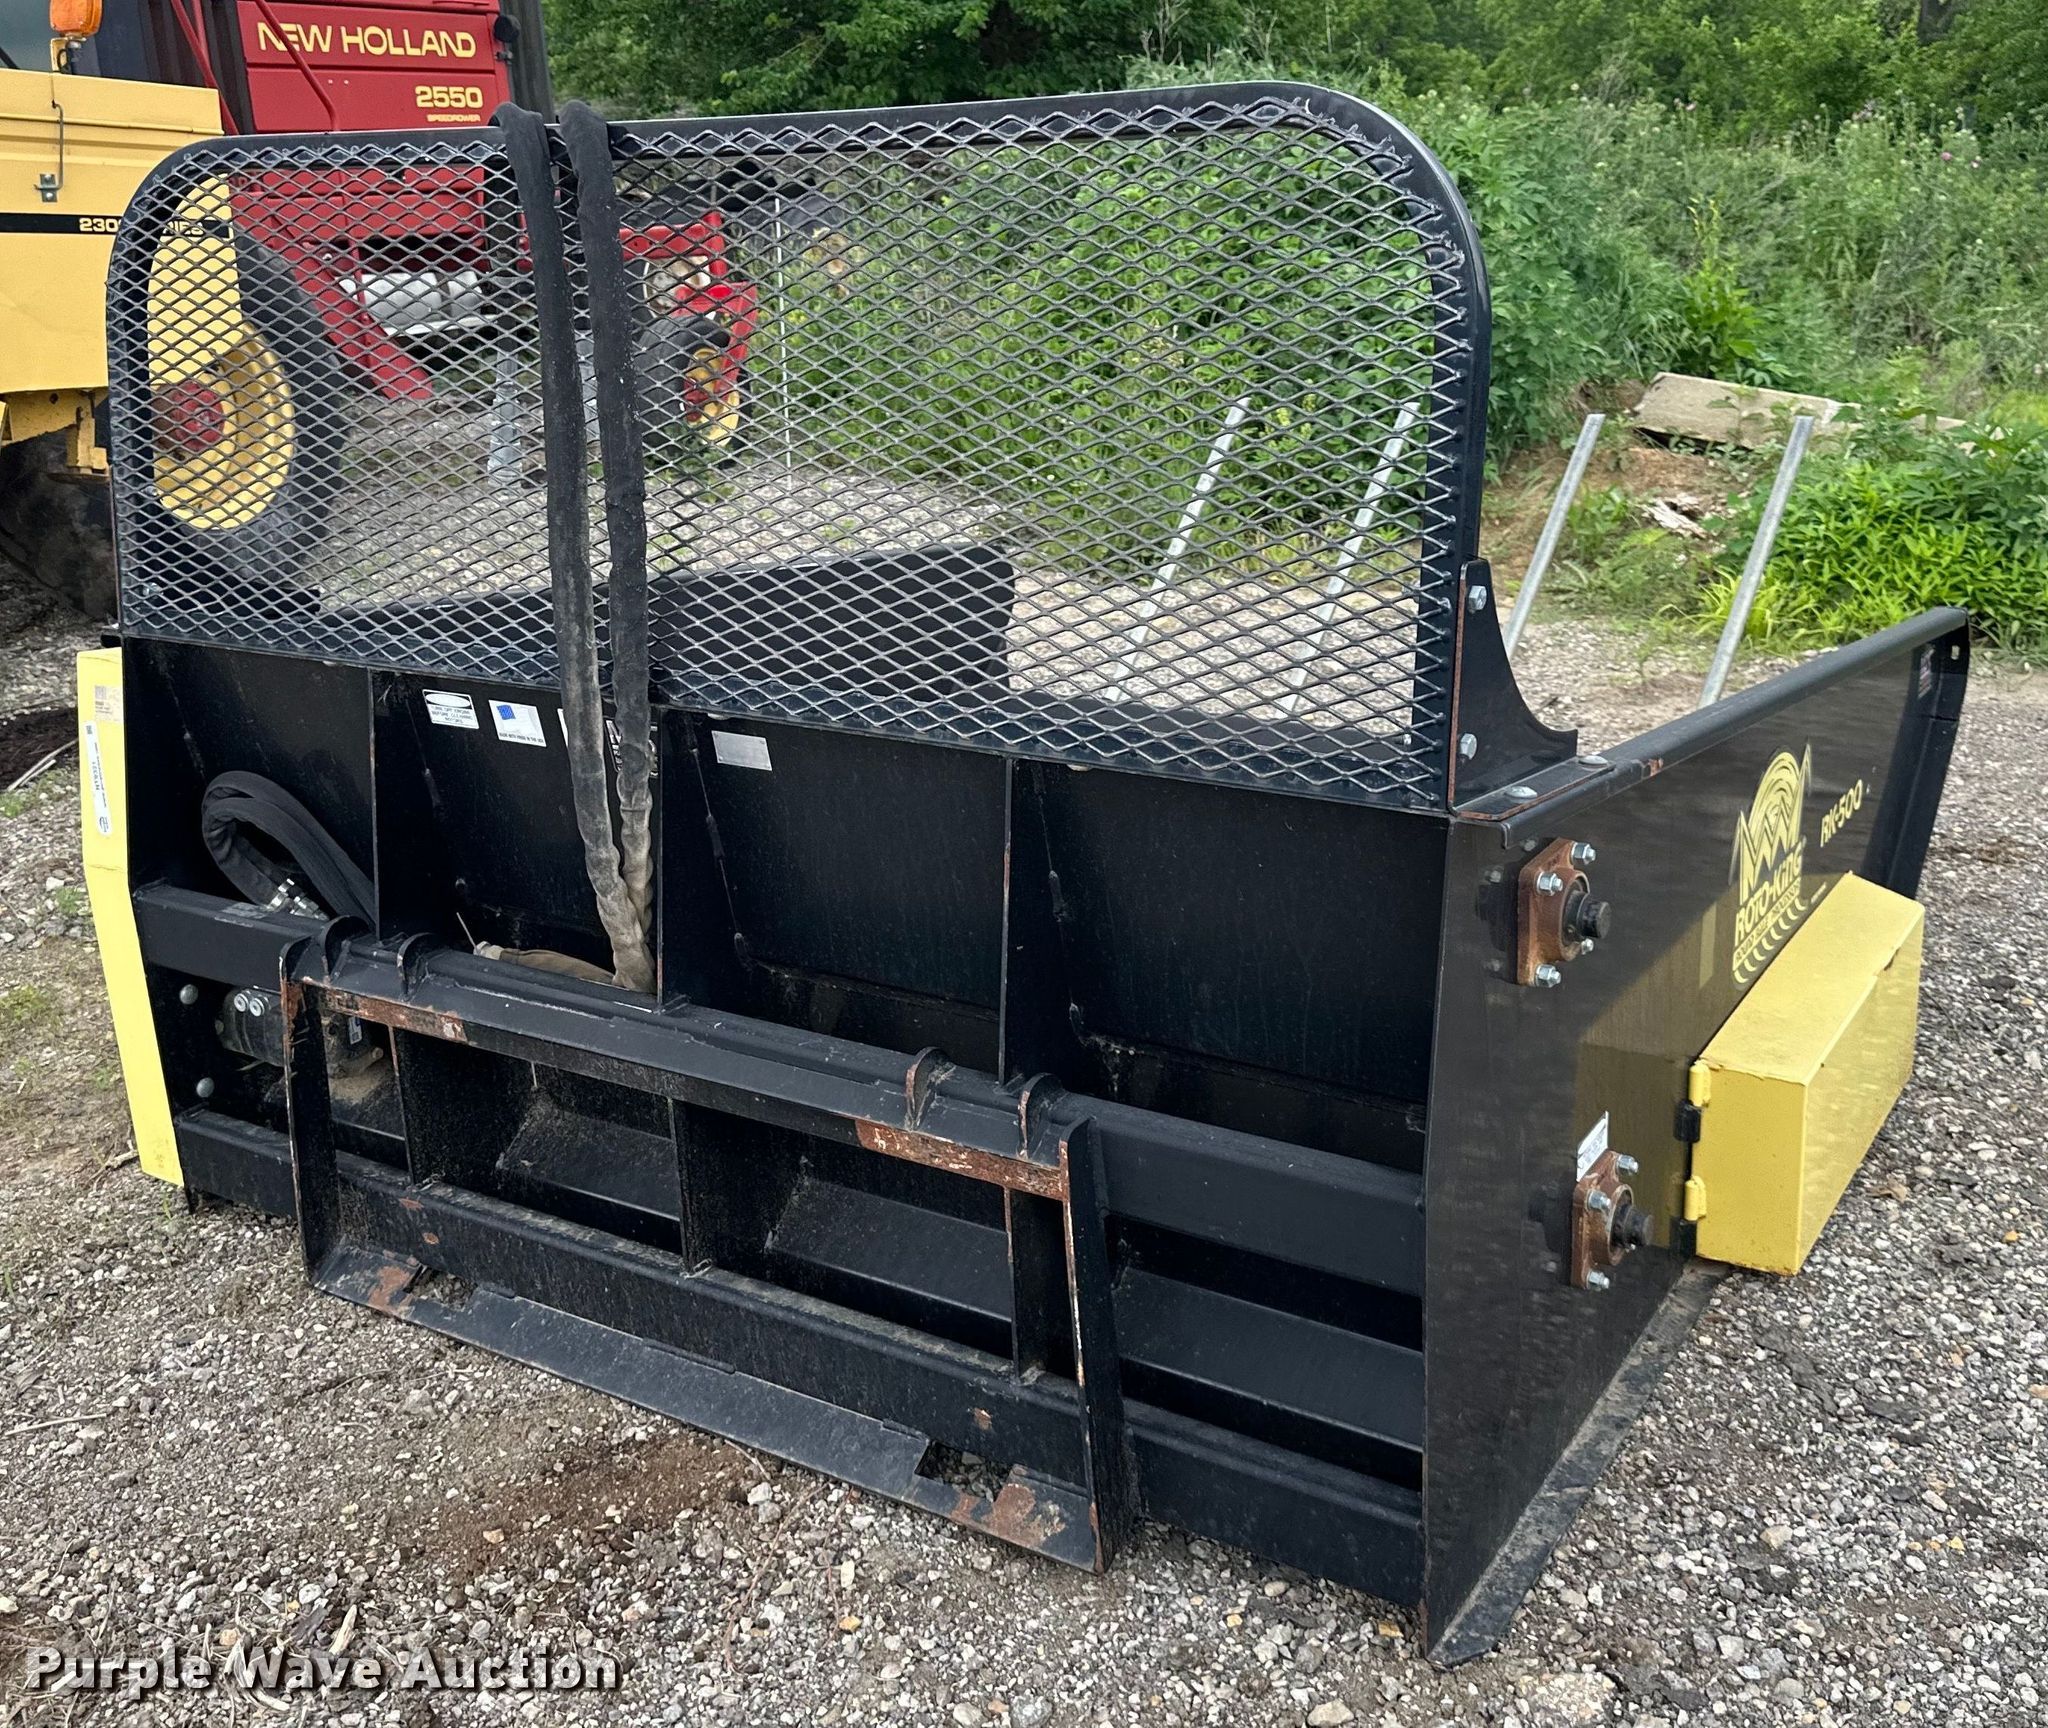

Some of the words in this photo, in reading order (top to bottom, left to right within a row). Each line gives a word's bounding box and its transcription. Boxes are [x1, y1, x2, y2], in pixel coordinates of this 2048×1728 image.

[257, 22, 332, 53] NEW
[341, 25, 476, 58] HOLLAND
[415, 85, 483, 109] 2550
[79, 217, 121, 232] 230
[1820, 779, 1863, 848] RK-500
